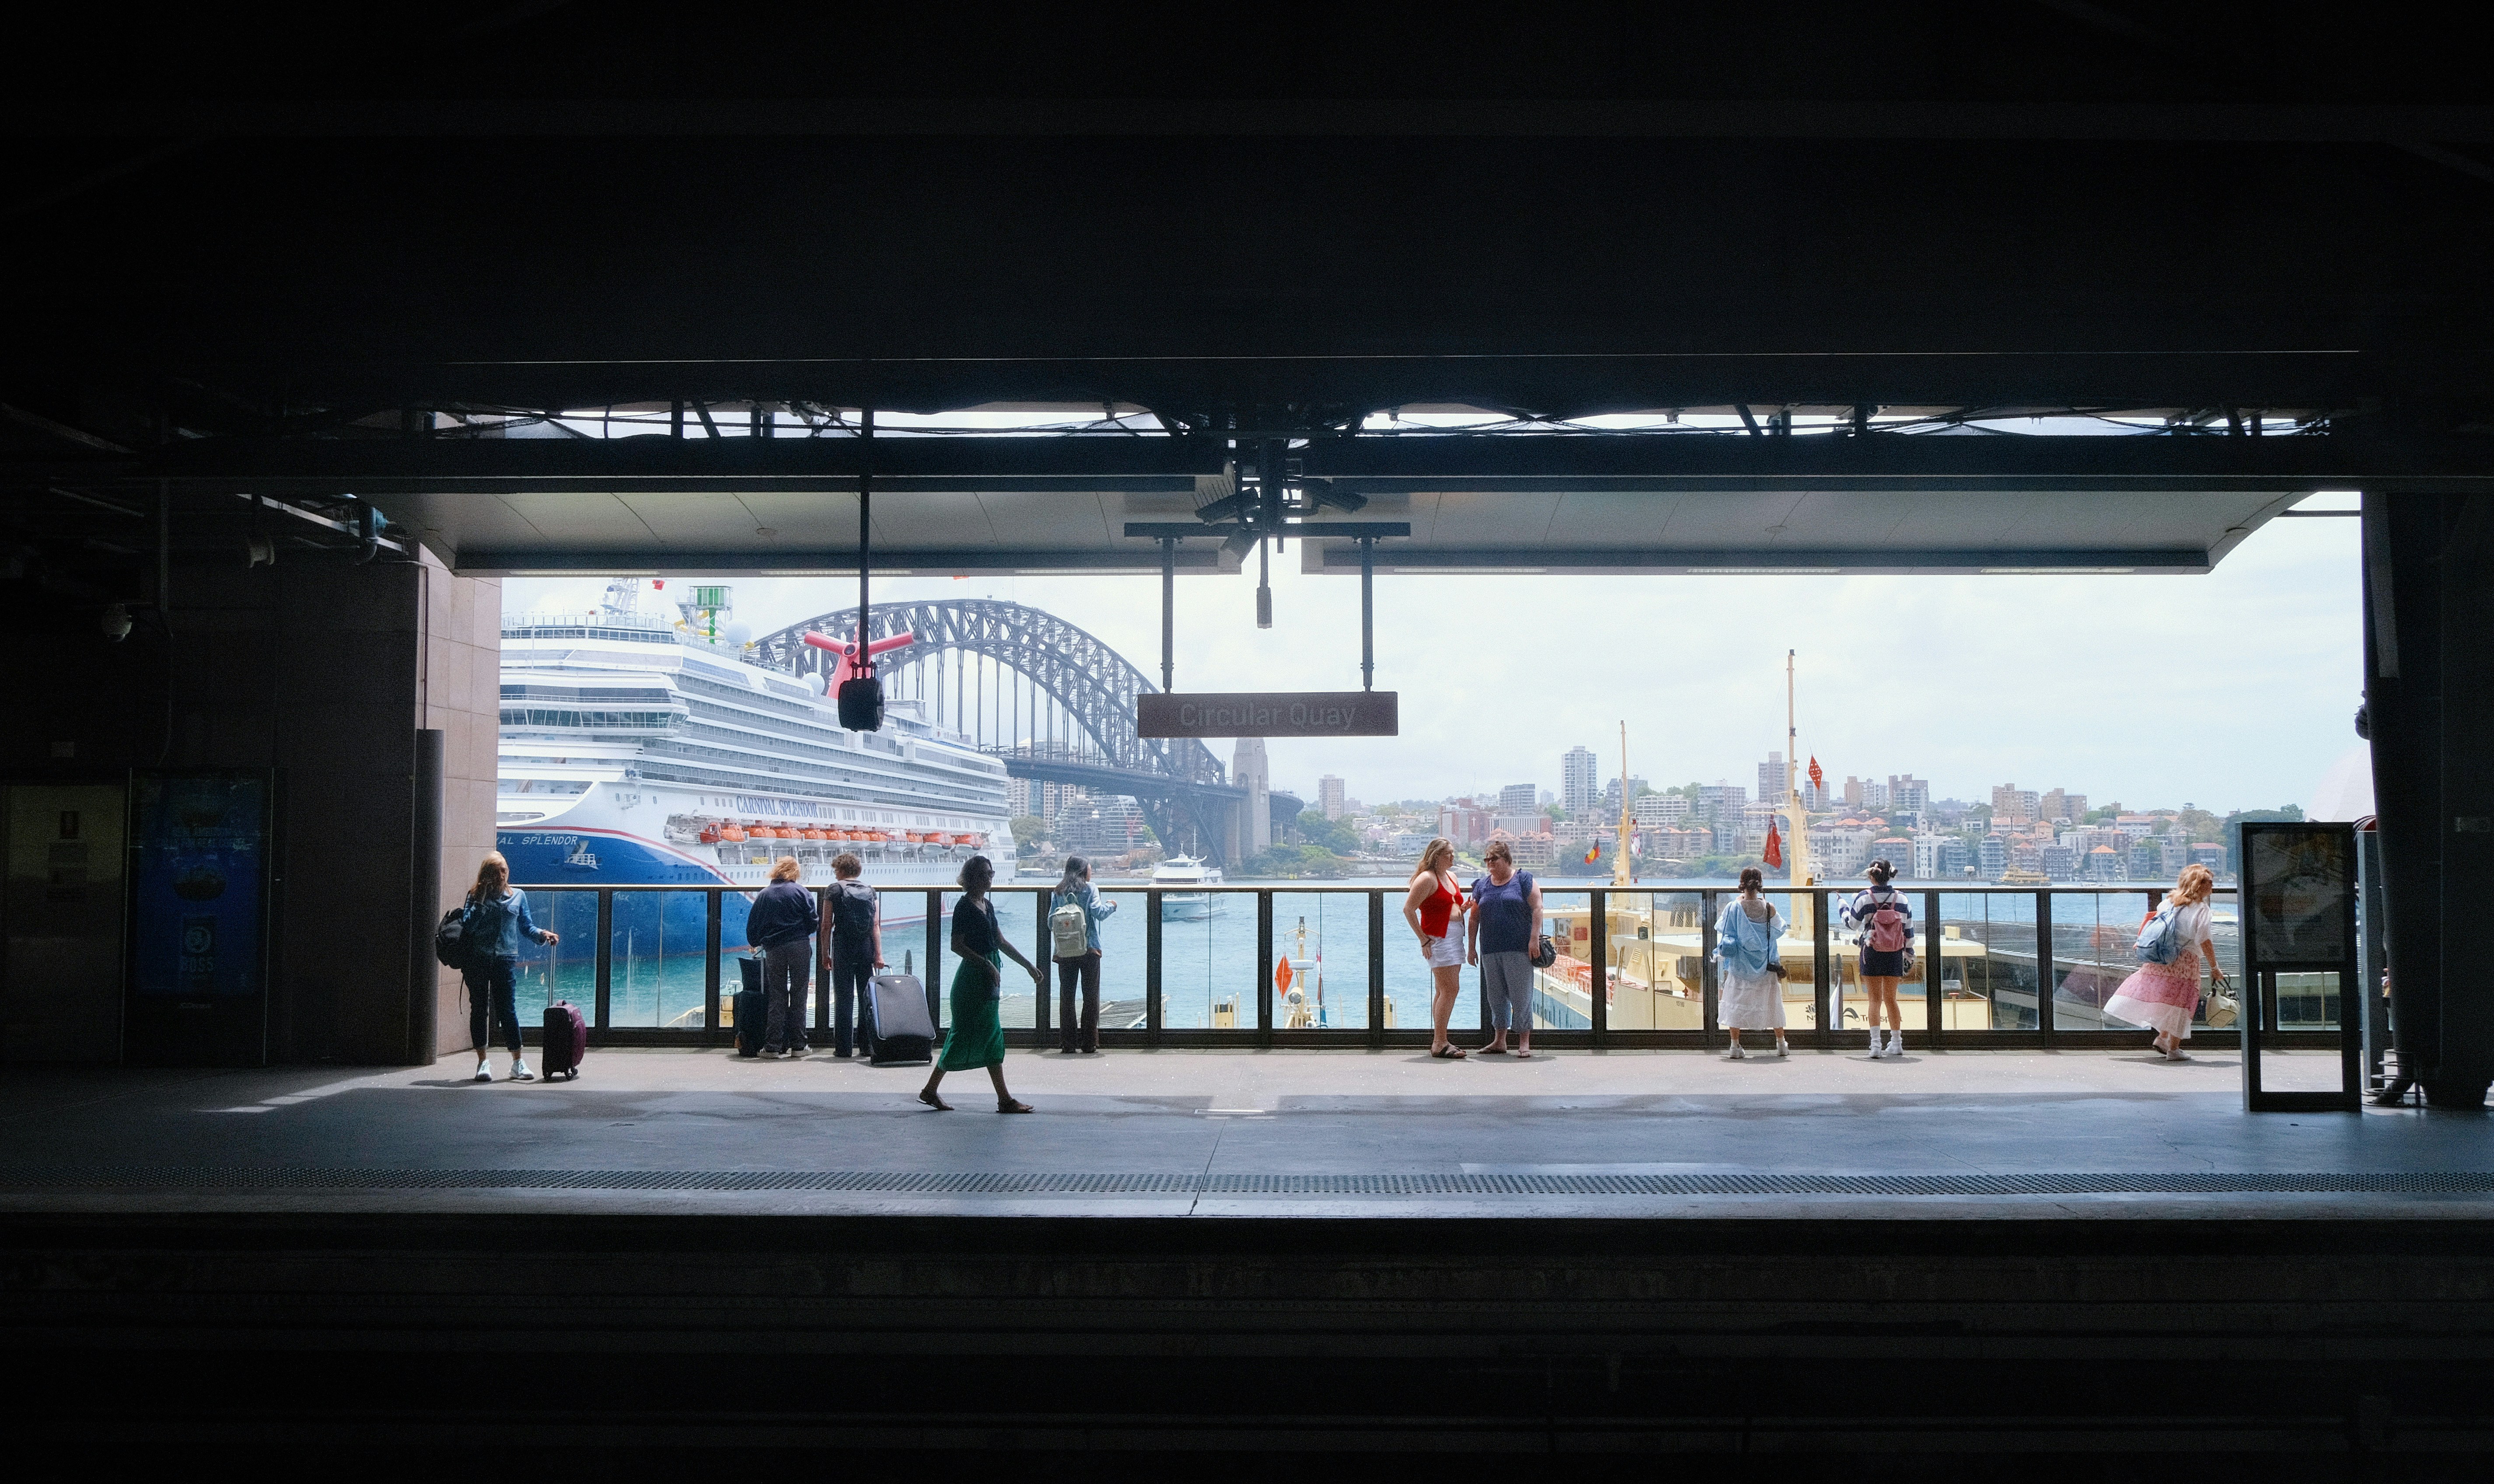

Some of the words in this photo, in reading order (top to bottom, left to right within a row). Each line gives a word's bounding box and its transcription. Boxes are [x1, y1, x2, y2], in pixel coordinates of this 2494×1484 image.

[1179, 702, 1282, 726] Circular
[1289, 702, 1357, 730] Quay
[737, 796, 778, 815] CARNIVAL
[779, 800, 819, 818] SPLENDOR
[521, 836, 578, 845] SPLENDOR
